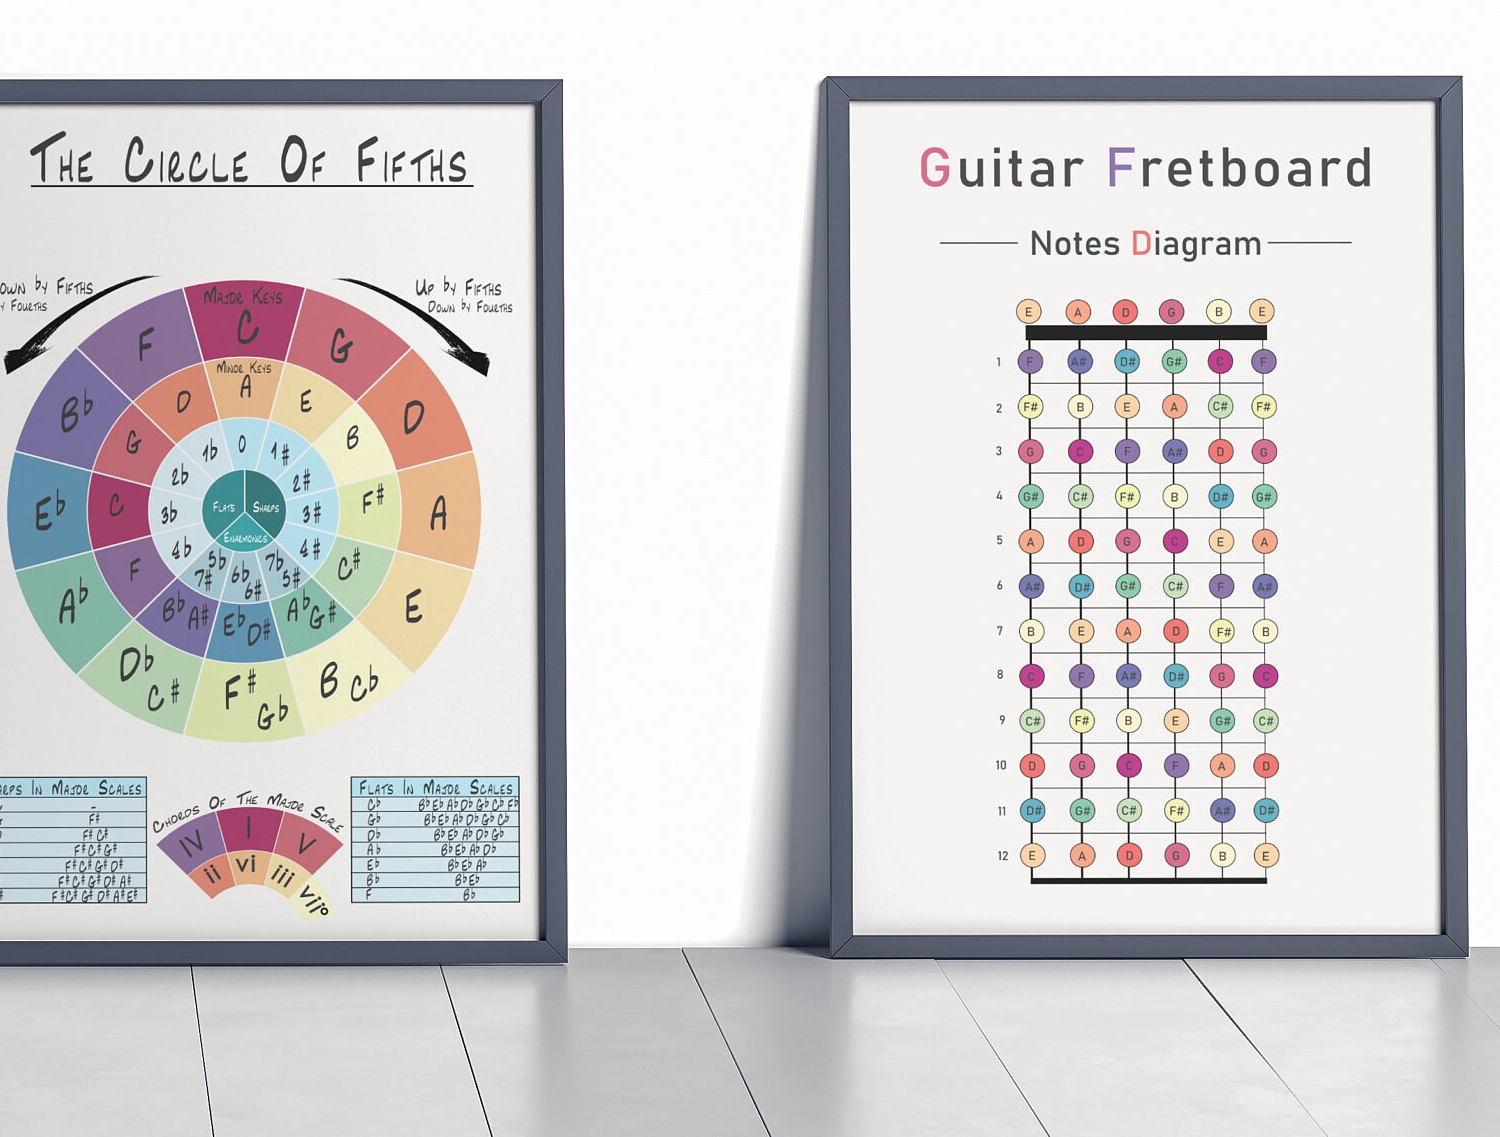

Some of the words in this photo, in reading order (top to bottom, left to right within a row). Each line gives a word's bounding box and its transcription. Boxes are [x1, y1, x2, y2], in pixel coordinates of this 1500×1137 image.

[921, 147, 1084, 187] Guitar
[1109, 147, 1371, 187] Fretboard
[1031, 231, 1120, 256] Notes
[1132, 231, 1262, 262] Diagram
[1026, 307, 1032, 316] E
[1074, 308, 1082, 317] A
[1123, 308, 1129, 317] D
[1168, 308, 1175, 317] G
[1216, 307, 1222, 316] B
[1259, 307, 1265, 316] E
[238, 309, 259, 344] C
[138, 326, 155, 362] F
[330, 328, 354, 364] G
[997, 357, 1000, 366] 1
[240, 374, 251, 398] A
[177, 390, 191, 414] D
[300, 390, 313, 413] E
[997, 404, 1002, 413] 2
[1024, 402, 1037, 411] F#
[1077, 403, 1084, 412] B
[1124, 402, 1130, 412] E
[1171, 402, 1178, 411] A
[1213, 402, 1227, 411] C#
[1257, 402, 1270, 411] F#
[403, 399, 425, 435] D
[125, 430, 142, 455] G
[345, 425, 360, 450] B
[996, 446, 1001, 455] 3
[1027, 447, 1034, 456] G
[1217, 447, 1224, 456] D
[1260, 448, 1267, 457] G
[108, 493, 124, 517] C
[996, 491, 1002, 500] 4
[1073, 492, 1087, 501] C#
[1120, 492, 1134, 501] F#
[1171, 493, 1178, 502] B
[429, 494, 448, 531] A
[997, 535, 1002, 545] 5
[1027, 537, 1034, 546] A
[1078, 537, 1084, 546] D
[1124, 537, 1131, 546] G
[1217, 537, 1224, 546] E
[1261, 537, 1268, 546] A
[130, 558, 142, 582] F
[997, 580, 1002, 590] 6
[1169, 582, 1182, 591] C#
[404, 588, 423, 624] E
[997, 626, 1002, 635] 7
[1028, 627, 1034, 636] B
[1078, 627, 1084, 636] E
[1124, 627, 1131, 636] A
[1173, 626, 1180, 636] D
[1218, 628, 1230, 636] F#
[1263, 627, 1269, 636] B
[320, 661, 339, 698] B
[997, 670, 1003, 679] 8
[1218, 672, 1225, 681] G
[1000, 715, 1005, 724] 9
[1026, 717, 1040, 726] C#
[1076, 716, 1089, 725] F#
[1125, 716, 1132, 725] B
[1173, 716, 1179, 725] E
[1259, 717, 1273, 726] C#
[996, 760, 1006, 770] 10
[1029, 761, 1036, 770] D
[1079, 761, 1085, 770] G
[1218, 761, 1225, 770] A
[1263, 762, 1270, 771] D
[998, 807, 1005, 816] 11
[1122, 806, 1136, 815] C#
[1170, 806, 1183, 815] F#
[299, 833, 316, 854] V
[236, 855, 255, 872] vi
[998, 851, 1008, 860] 12
[1029, 851, 1036, 860] E
[1078, 851, 1086, 860] A
[1126, 851, 1133, 860] D
[1173, 851, 1179, 860] G
[1220, 852, 1226, 861] B
[1263, 852, 1269, 861] E
